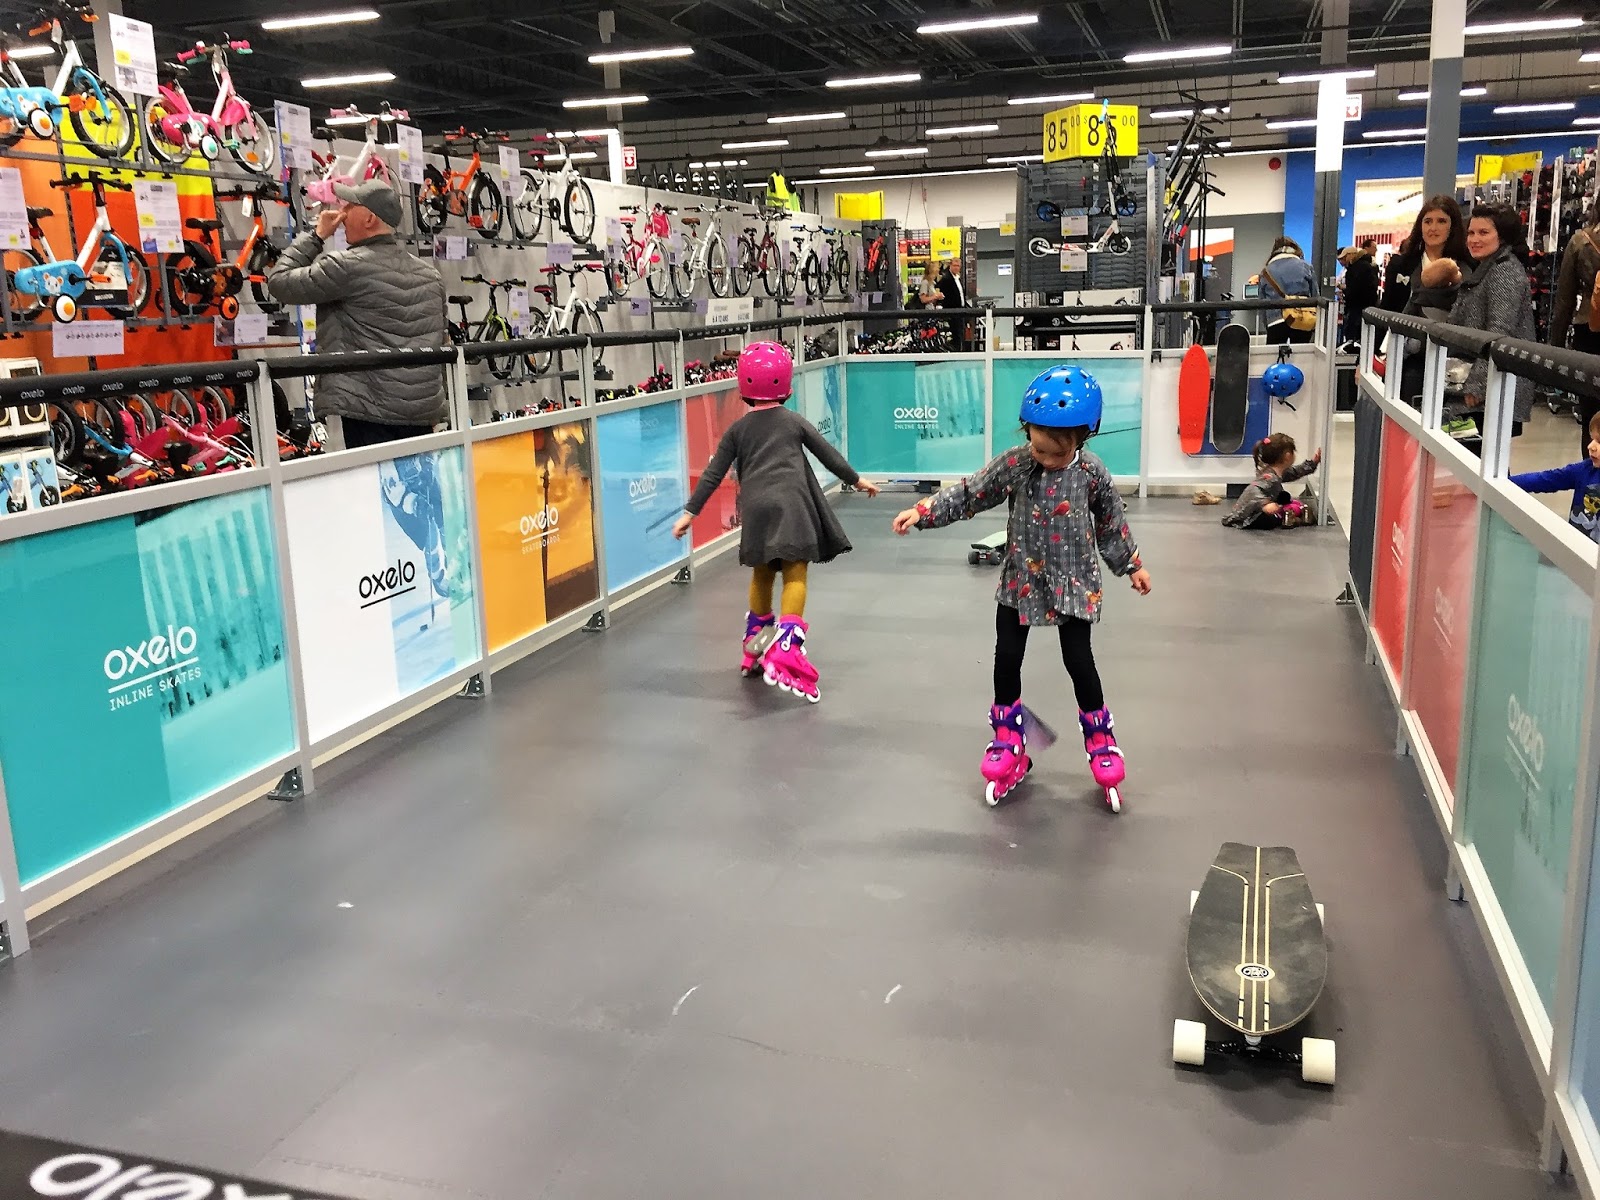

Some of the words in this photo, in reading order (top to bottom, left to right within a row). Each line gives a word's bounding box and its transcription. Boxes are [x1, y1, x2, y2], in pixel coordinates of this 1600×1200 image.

[20, 389, 45, 400] oxelo
[62, 385, 85, 396] oxelo
[102, 382, 124, 392] oxelo
[139, 378, 159, 388] oxelo
[173, 375, 193, 385] oxelo
[893, 405, 938, 419] oxelo
[629, 473, 657, 498] oxelo
[519, 504, 559, 536] oxelo
[358, 559, 416, 599] oxelo
[103, 624, 197, 681] oxelo
[109, 684, 154, 712] INLINE
[158, 667, 202, 693] SKATES
